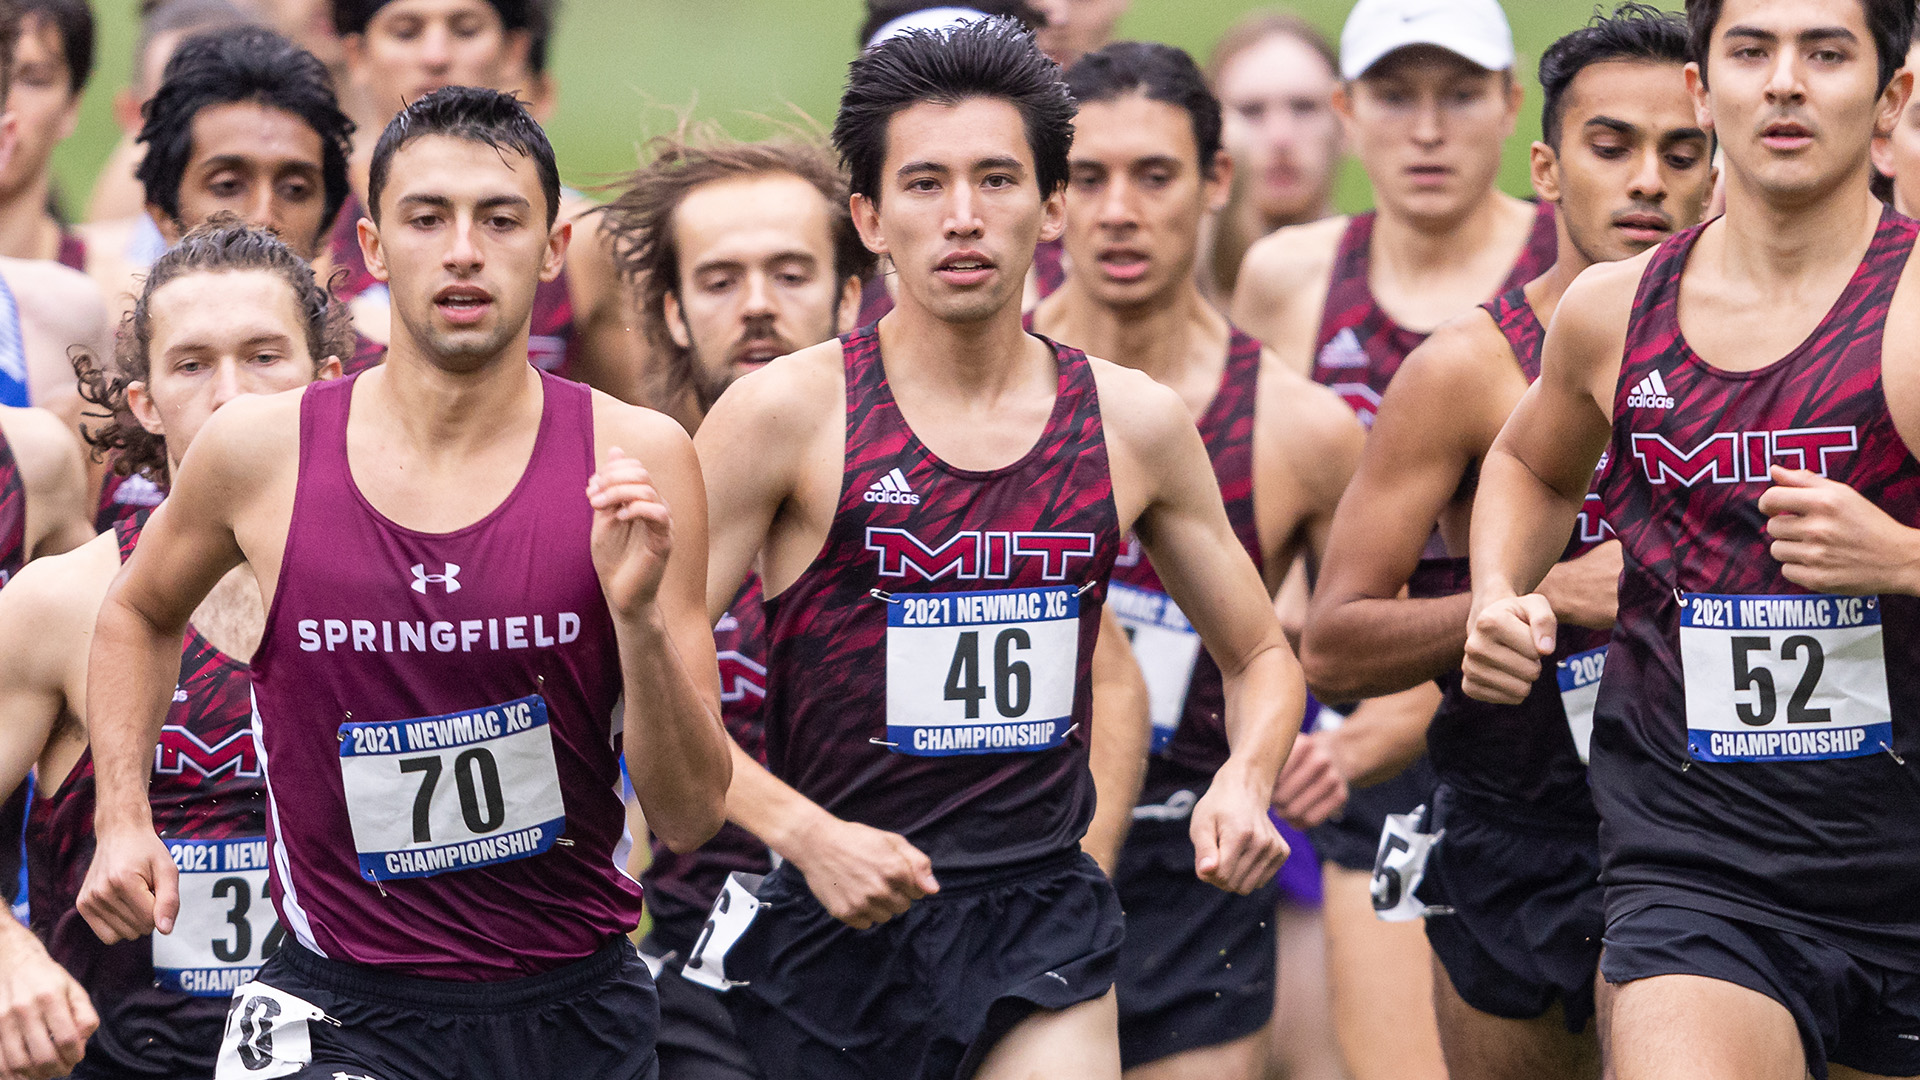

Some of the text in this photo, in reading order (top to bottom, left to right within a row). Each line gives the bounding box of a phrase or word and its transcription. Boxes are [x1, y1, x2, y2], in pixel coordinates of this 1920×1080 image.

[1627, 393, 1675, 409] adidas
[1631, 426, 1857, 488] MIT
[863, 489, 920, 505] adidas
[866, 526, 1095, 581] MIT
[903, 590, 1067, 625] 2021 NEWMAC XC
[1692, 597, 1864, 628] 2021 NEWMAC XC
[298, 611, 581, 652] SPRINGFIELD
[943, 627, 1032, 719] 46
[1570, 650, 1608, 686] 202
[1731, 635, 1832, 727] 52
[352, 702, 533, 754] 2021 NEWMAC XC
[913, 721, 1056, 751] CHAMPIONSHIP
[1710, 728, 1866, 757] CHAMPIONSHIP
[399, 747, 505, 843] 70
[170, 841, 269, 871] 2021 NEW
[385, 827, 543, 874] CHAMPIONSHIP
